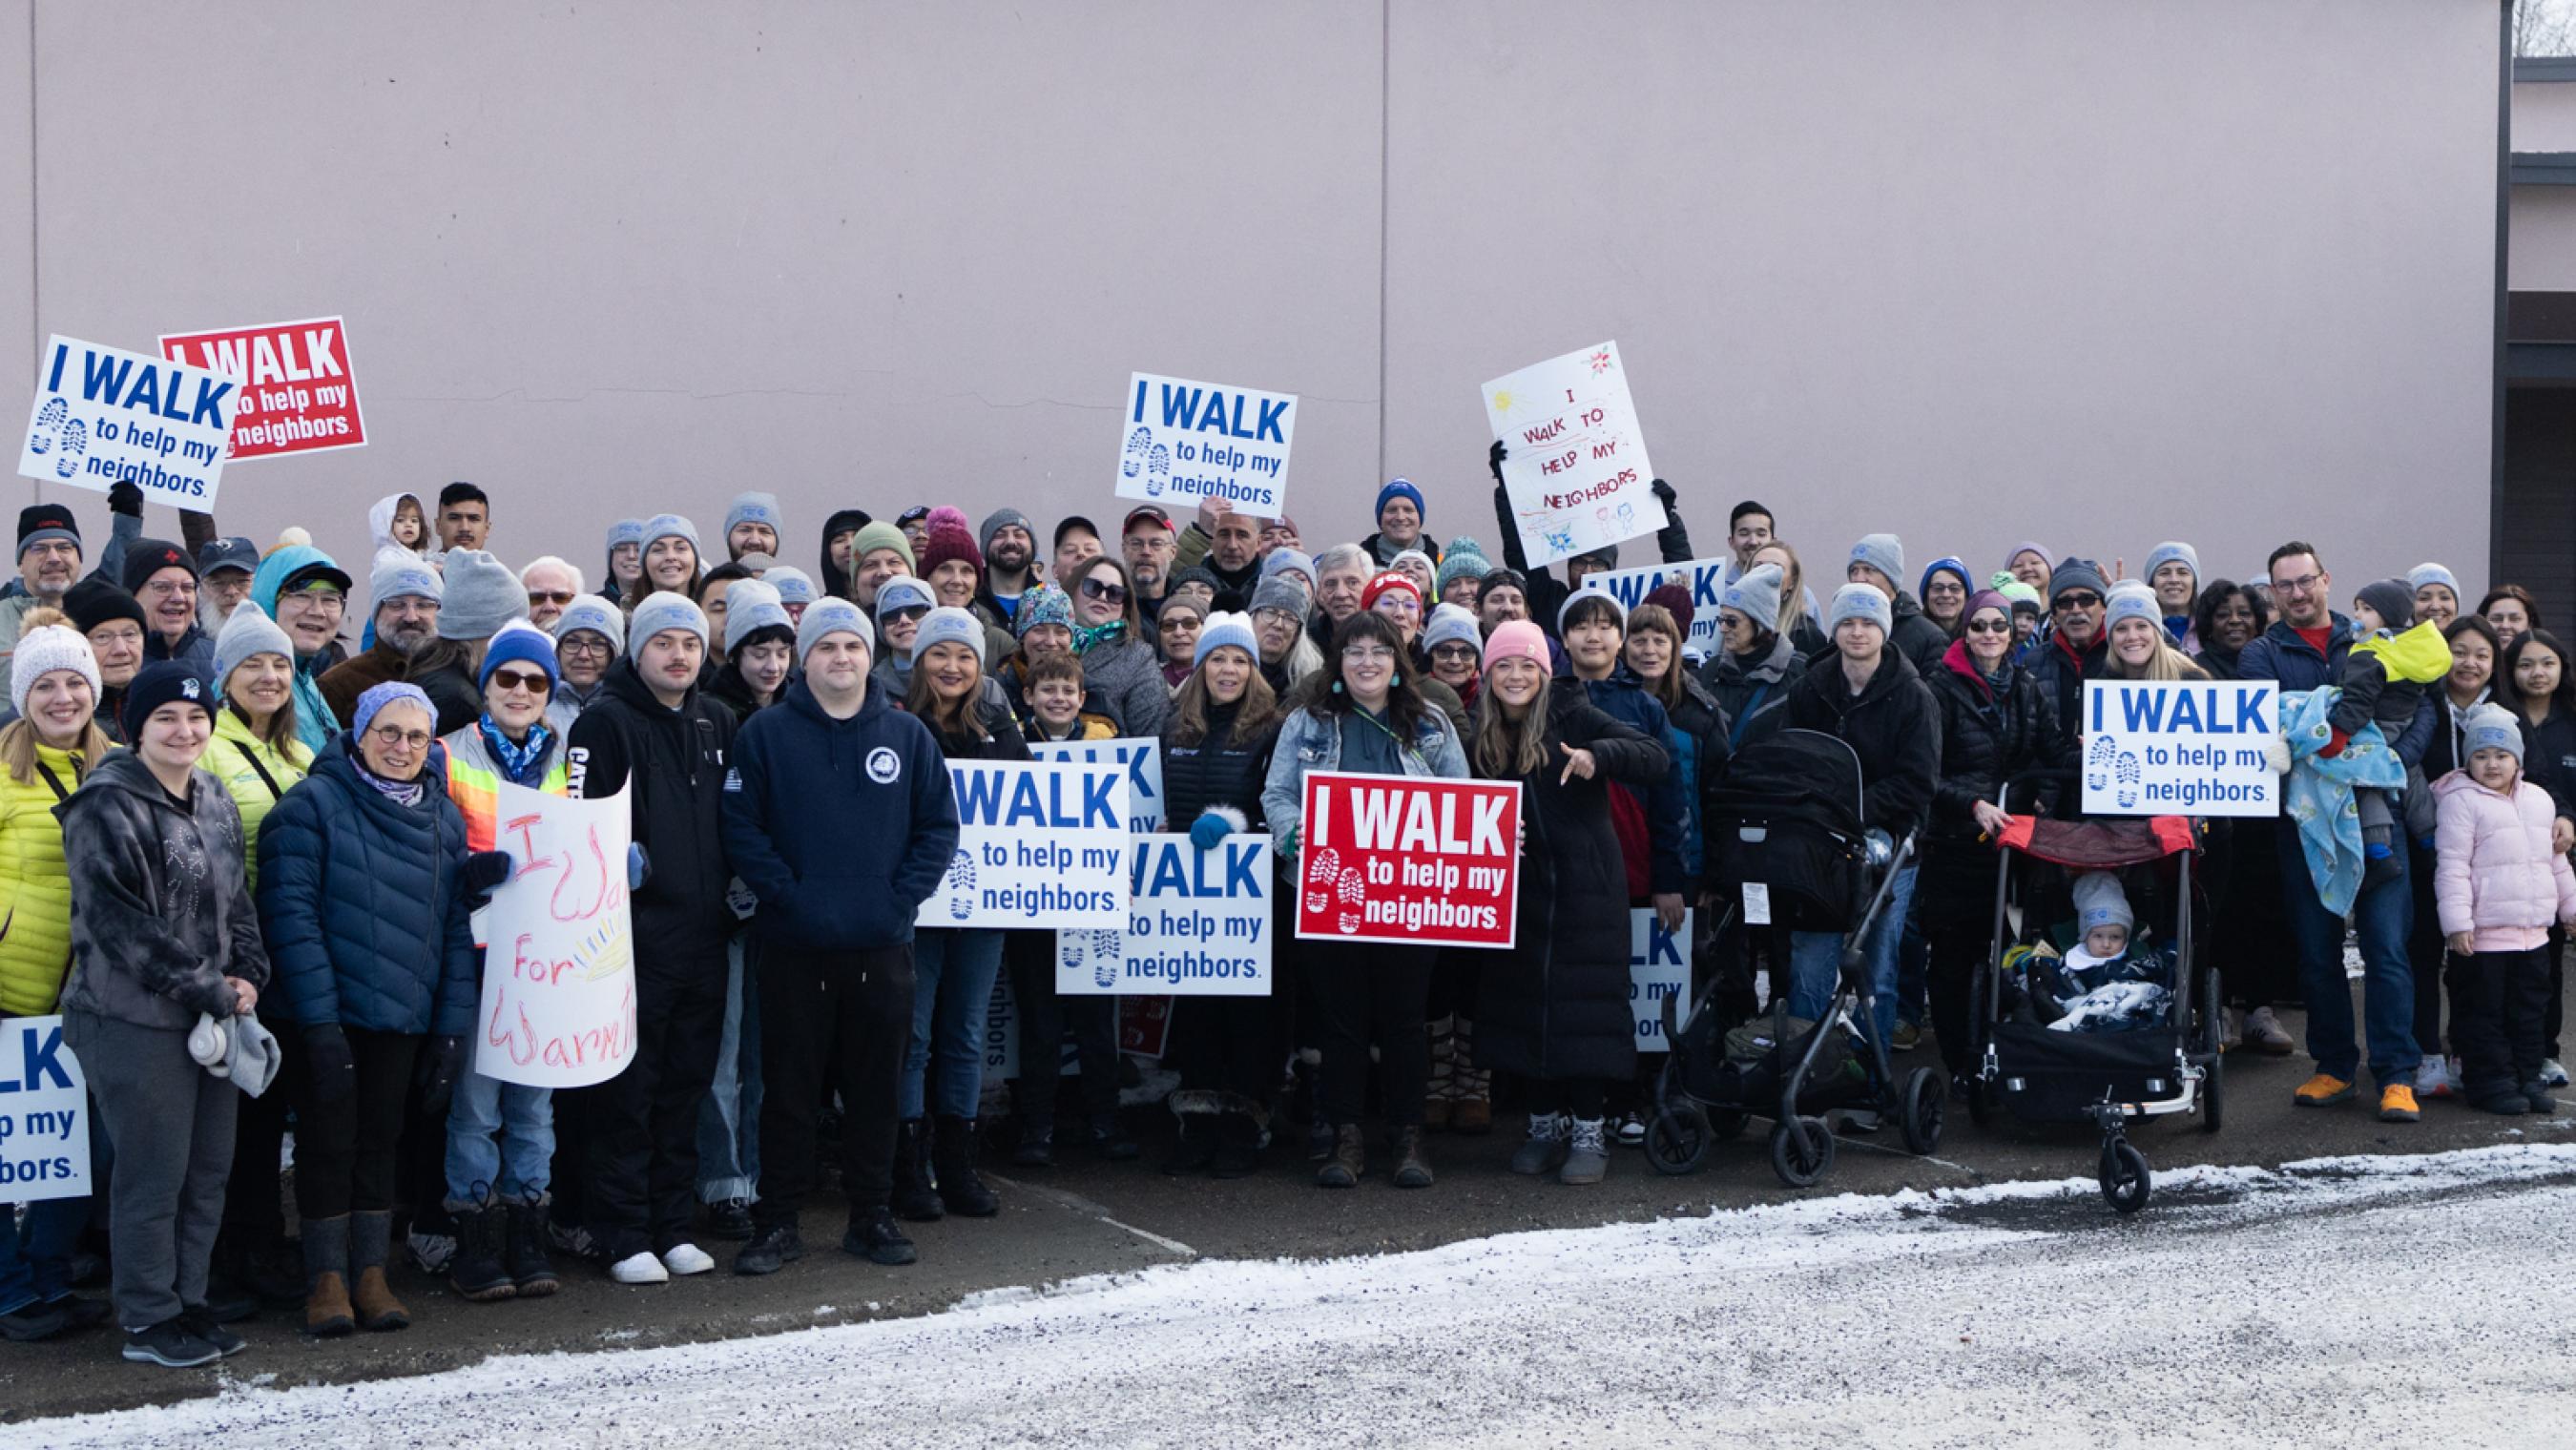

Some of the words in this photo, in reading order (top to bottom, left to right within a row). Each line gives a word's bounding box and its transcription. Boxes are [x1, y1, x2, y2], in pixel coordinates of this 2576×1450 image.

[200, 328, 343, 386] WALK
[48, 344, 68, 392] I
[84, 350, 234, 430] WALK
[259, 386, 310, 412] help
[315, 384, 346, 408] my
[1566, 389, 1575, 404] I
[237, 415, 352, 446] neighbors.
[1133, 380, 1148, 423] I
[1162, 383, 1290, 444] WALK
[1524, 417, 1567, 444] WALK
[1581, 408, 1604, 427] TO
[96, 417, 118, 440] to
[126, 423, 176, 454] help
[183, 442, 218, 466] my
[1176, 441, 1195, 461] to
[1201, 442, 1245, 472] help
[1251, 454, 1281, 478] my
[1541, 450, 1578, 475] HELP
[1592, 441, 1616, 460] MY
[1543, 467, 1637, 509] NEIGHBORS
[2092, 688, 2104, 732] I
[2120, 688, 2270, 734] WALK
[2146, 745, 2168, 766] to
[2176, 743, 2226, 772] help
[2235, 750, 2268, 772] my
[952, 769, 1120, 829] WALK
[2146, 778, 2270, 806] neighbors.
[1314, 785, 1330, 846] I
[1350, 787, 1508, 856] WALK
[506, 813, 557, 881] I
[982, 841, 1008, 866] to
[1017, 839, 1072, 875] help
[1082, 848, 1120, 876] my
[1367, 856, 1393, 885] to
[1402, 857, 1459, 894] help
[1467, 866, 1506, 897] my
[983, 882, 1120, 918] neighbors.
[1365, 896, 1501, 932] neighbors.
[1128, 912, 1152, 936] to
[1160, 909, 1215, 942] help
[1224, 917, 1262, 943] my
[514, 933, 573, 986] For
[1127, 951, 1262, 984] neighbors.
[26, 1109, 75, 1140] my
